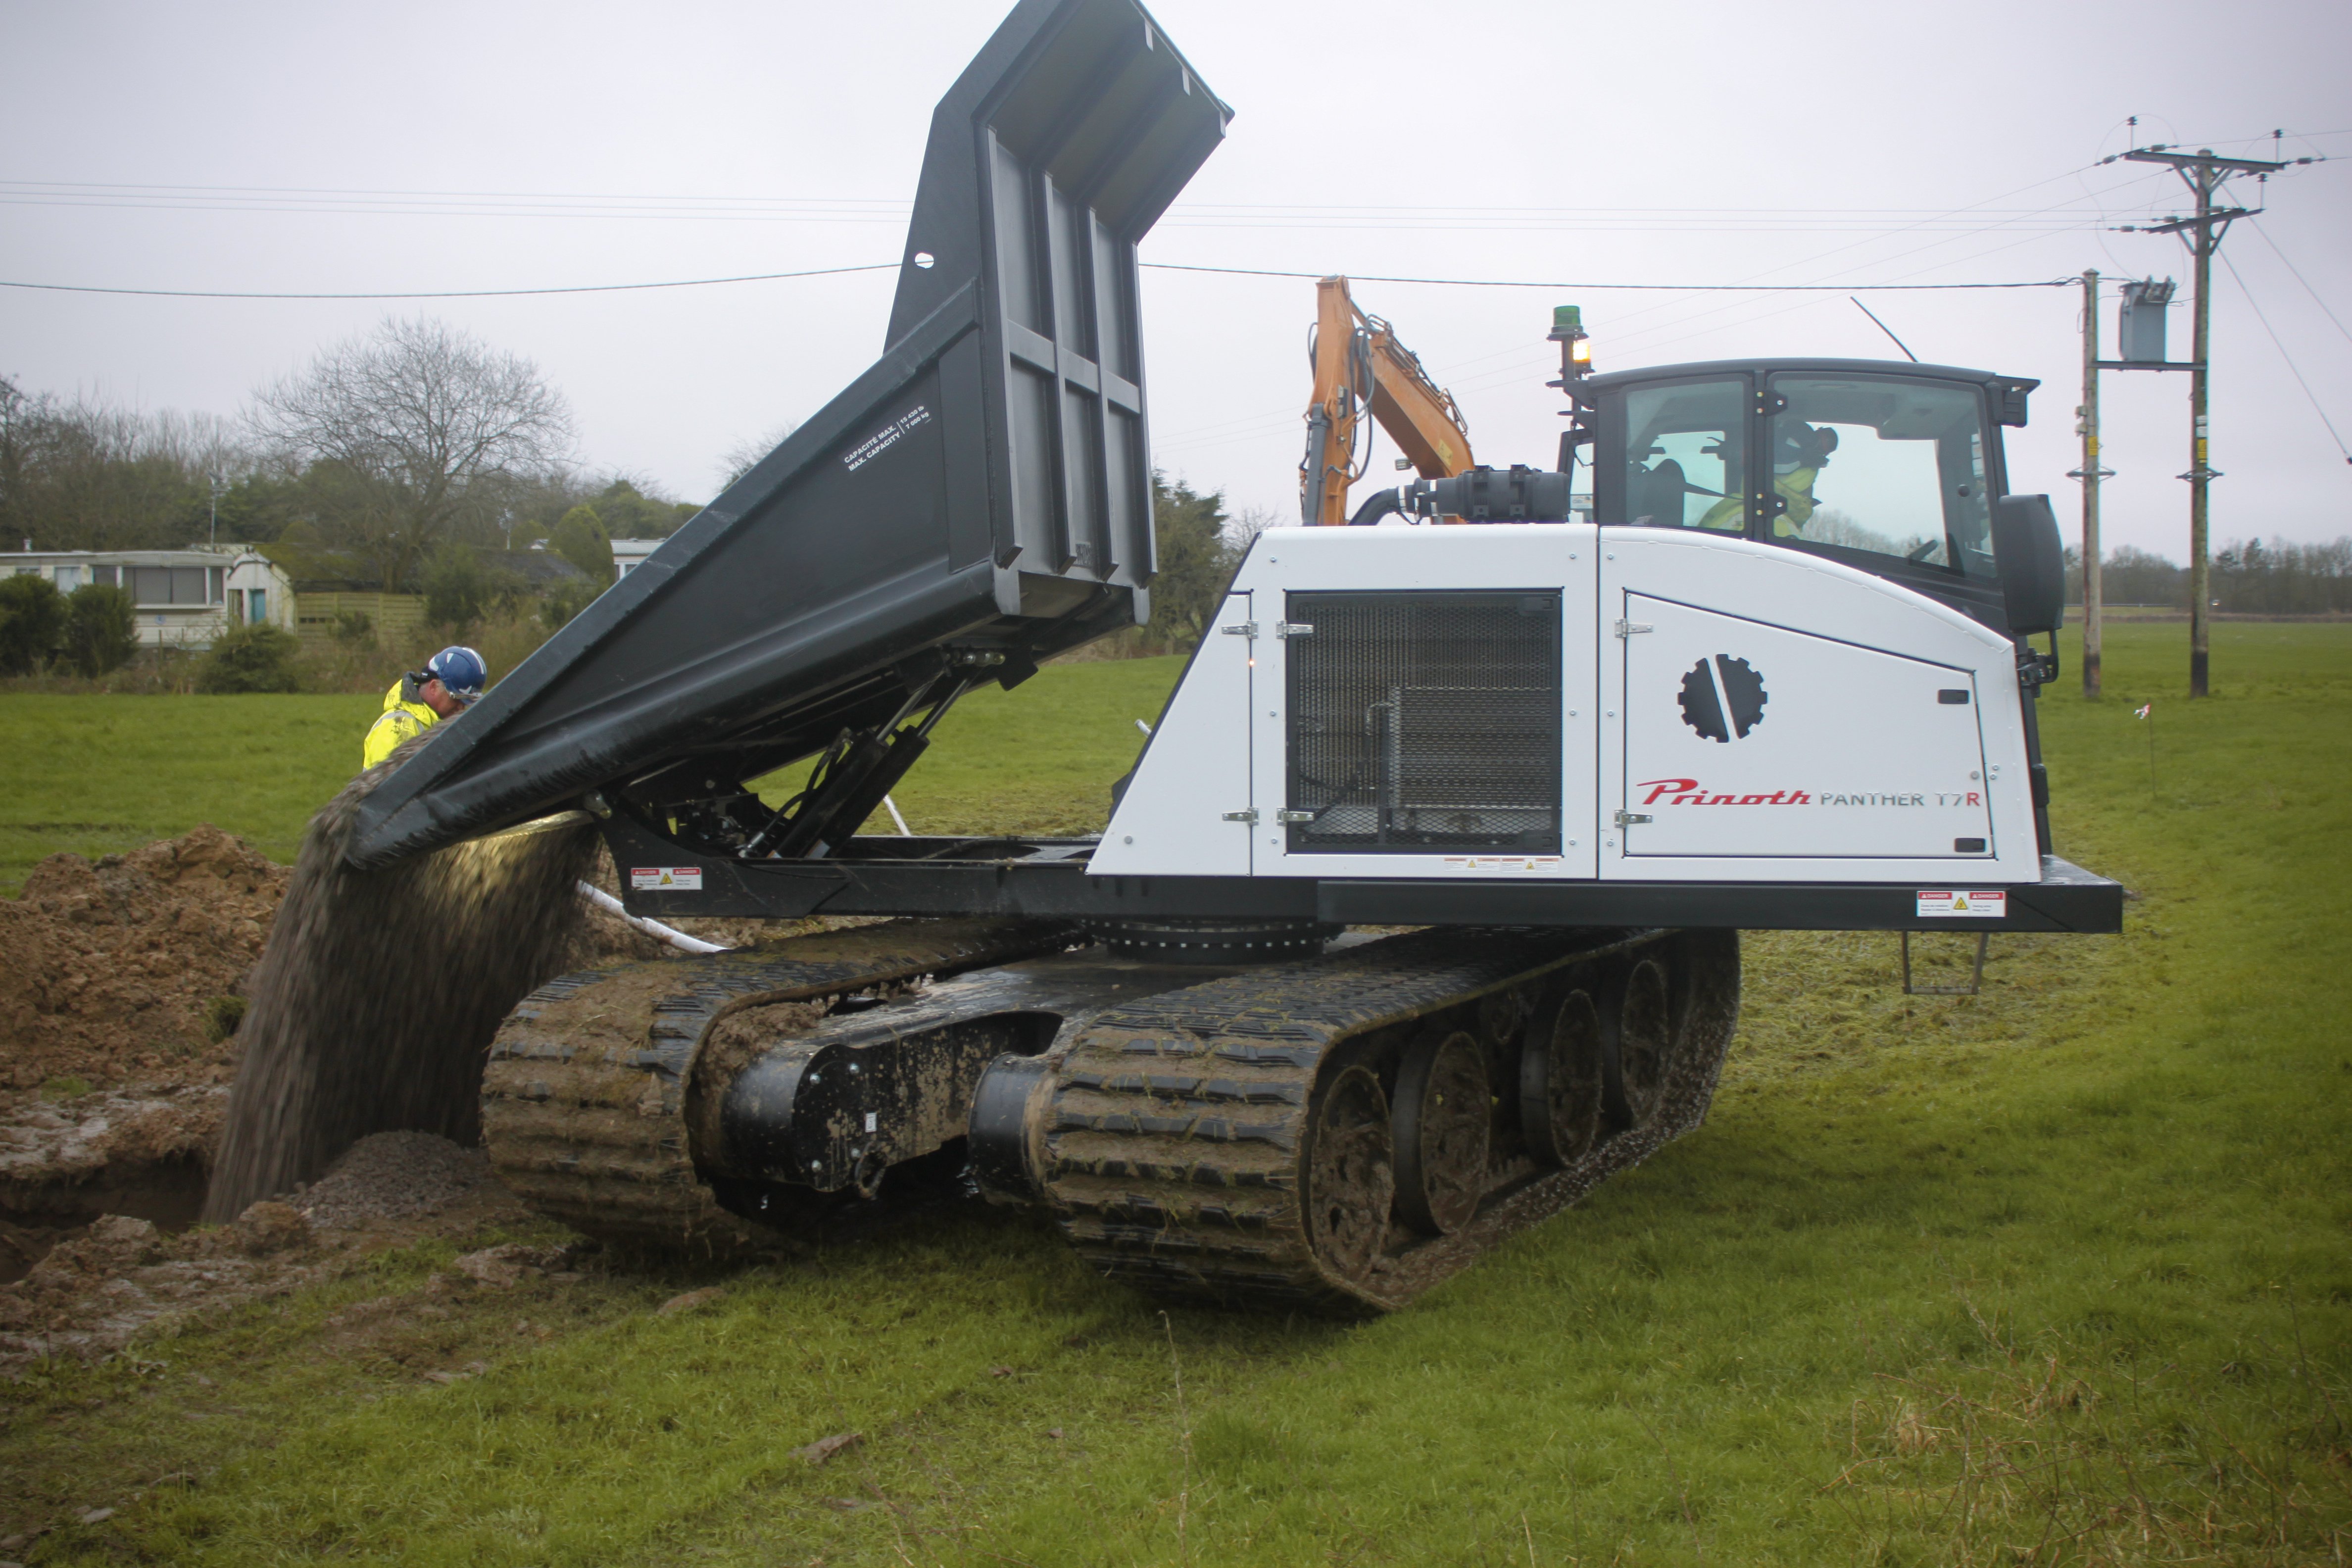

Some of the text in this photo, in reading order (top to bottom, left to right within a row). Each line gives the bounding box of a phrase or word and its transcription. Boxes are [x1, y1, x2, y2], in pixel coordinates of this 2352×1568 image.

[908, 409, 918, 419] 430
[910, 417, 921, 426] 000
[844, 426, 896, 463] CAPACITÉ MAX.
[848, 432, 900, 471] MAX. CAPACITY
[1637, 778, 1980, 806] Prinoth PANTHER T7R
